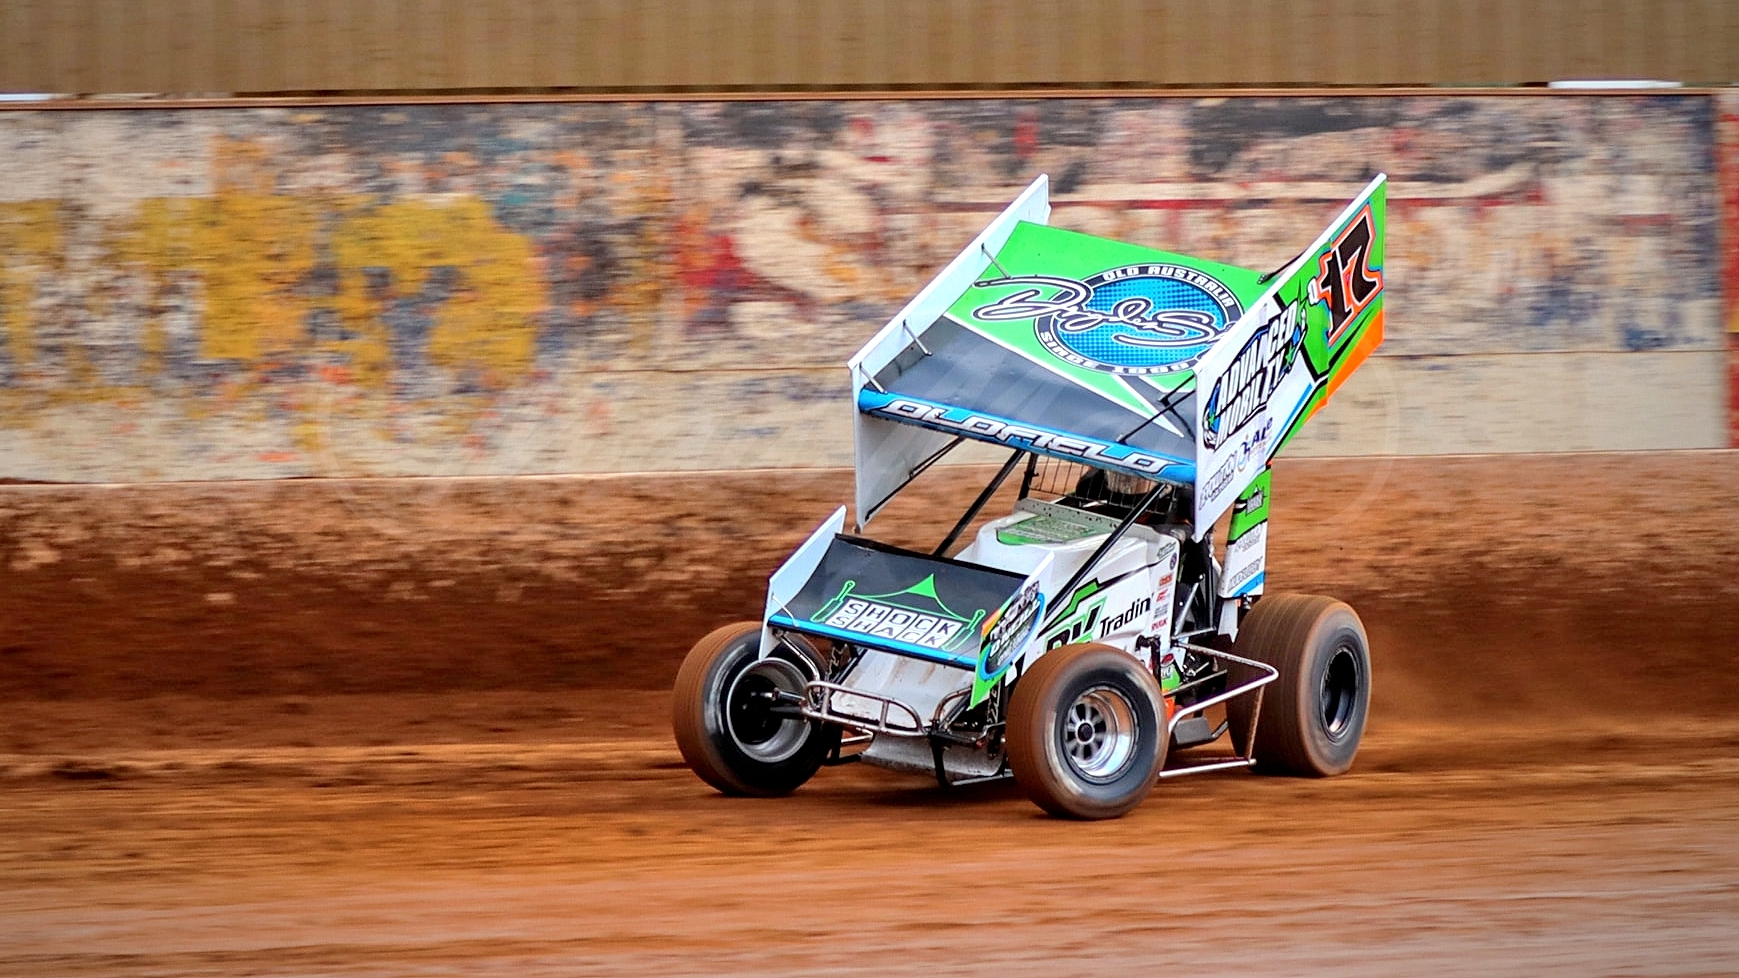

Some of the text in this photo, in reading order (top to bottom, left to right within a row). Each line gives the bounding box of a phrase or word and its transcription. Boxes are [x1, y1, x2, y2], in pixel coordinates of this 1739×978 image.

[1147, 265, 1234, 308] AUSTRALIA
[1040, 331, 1097, 370] SINCE
[1216, 300, 1299, 414] ADVANCED
[1215, 347, 1288, 451] MOBILITY
[885, 399, 1183, 475] OLDFIELD
[830, 615, 943, 647] SHACK
[842, 600, 957, 636] SHOCK
